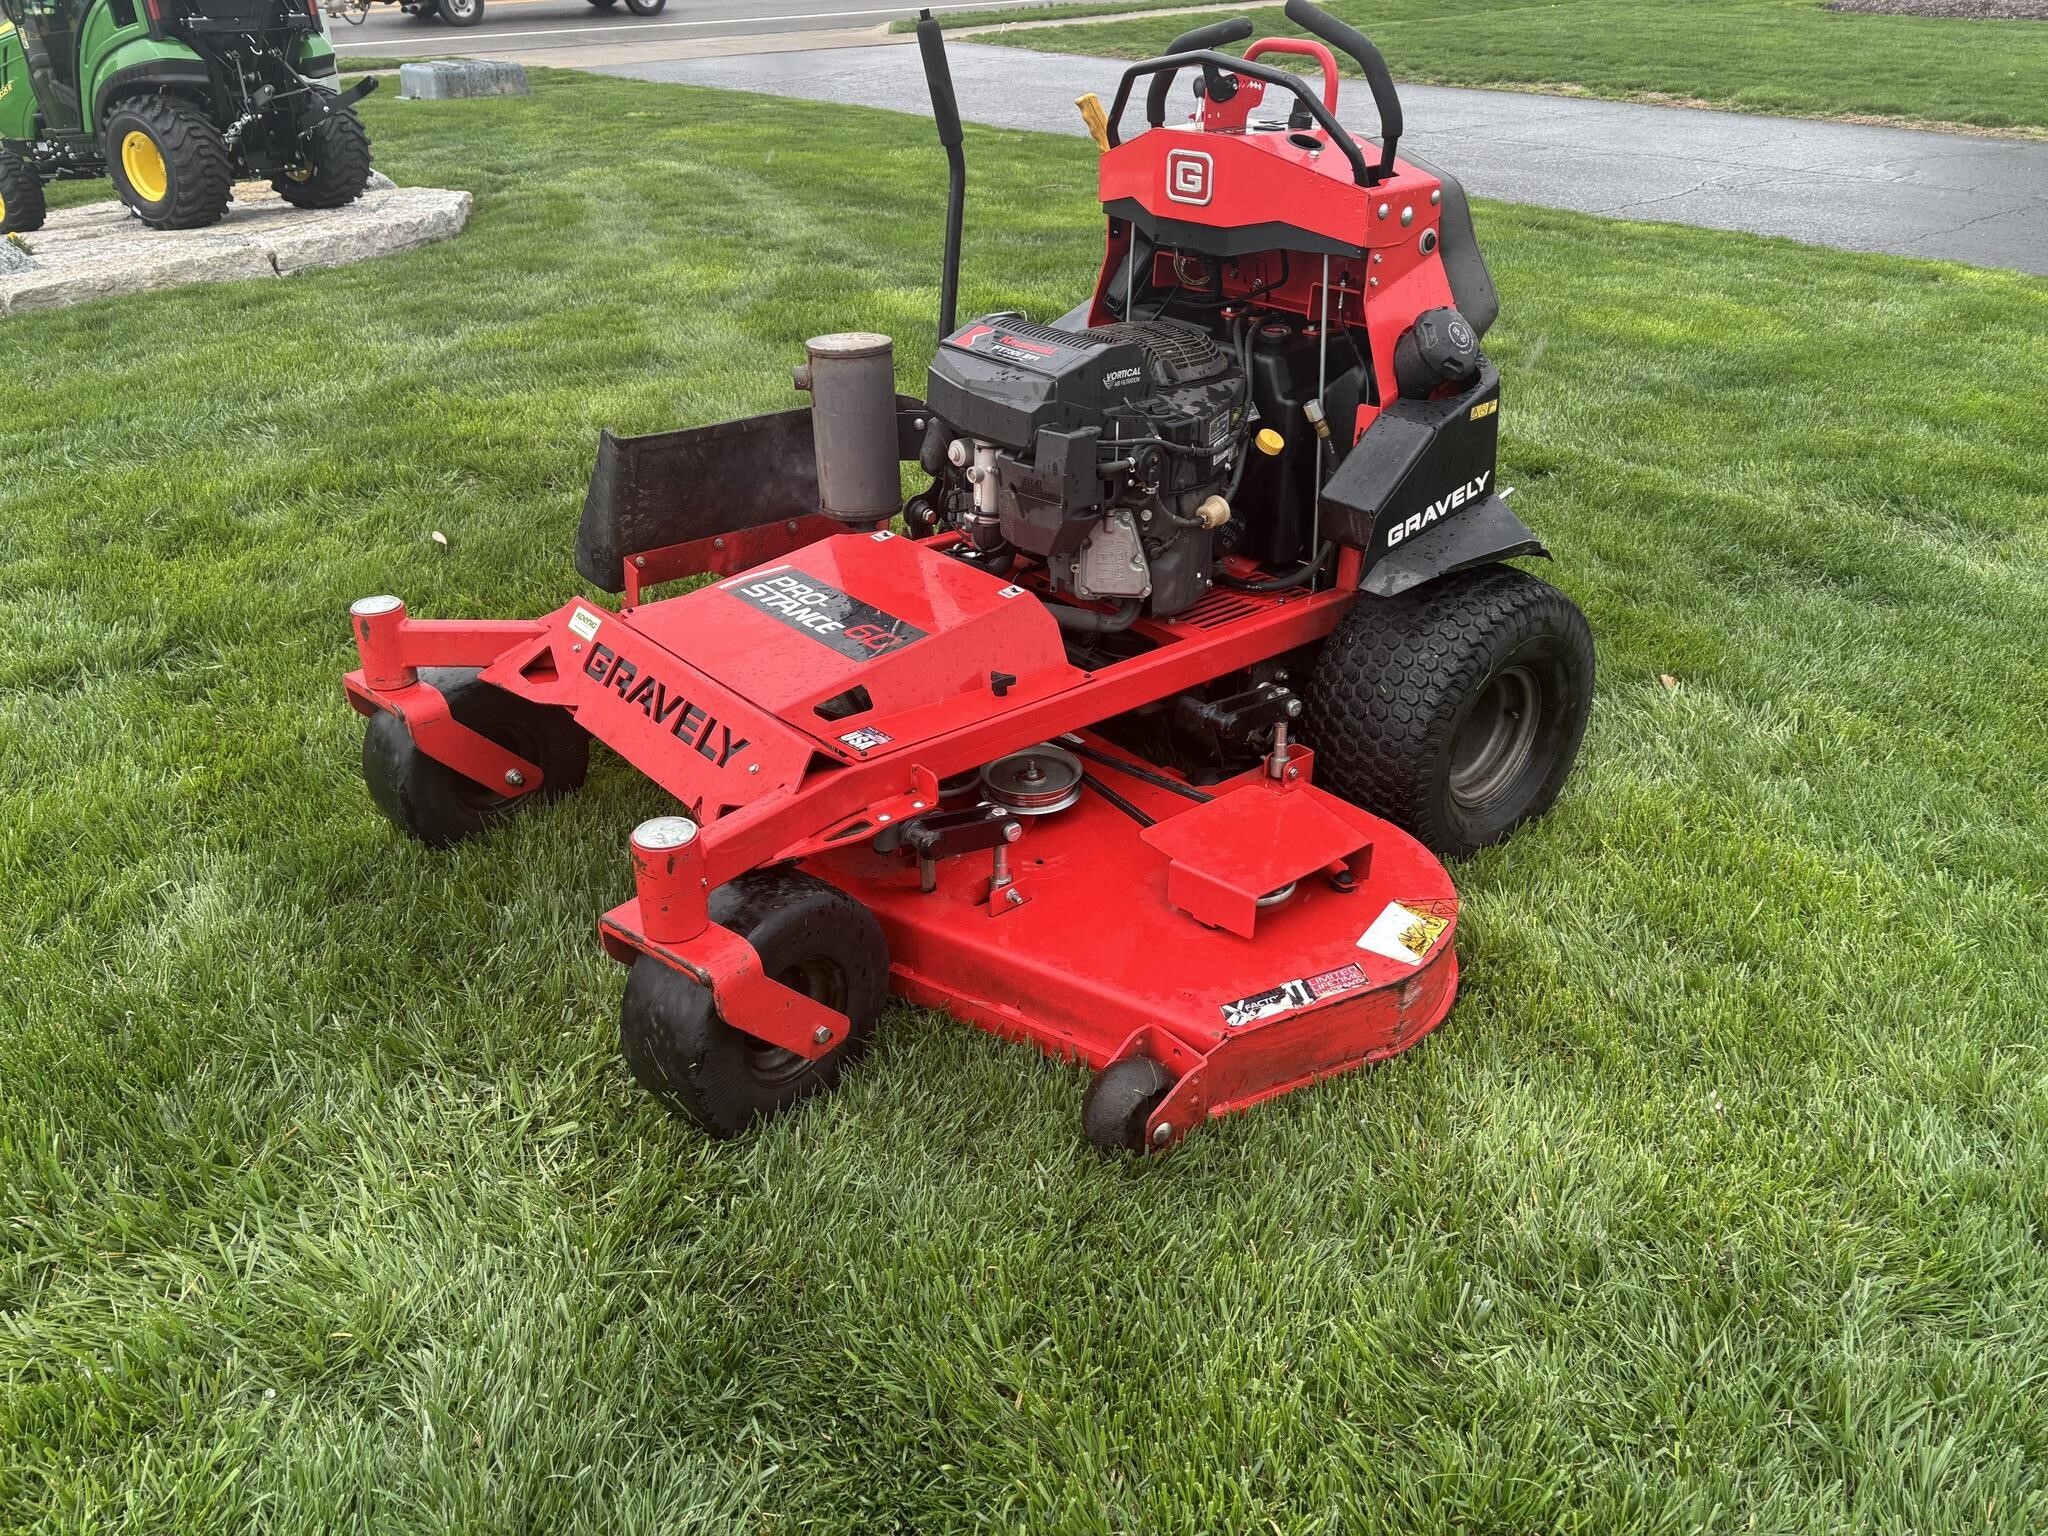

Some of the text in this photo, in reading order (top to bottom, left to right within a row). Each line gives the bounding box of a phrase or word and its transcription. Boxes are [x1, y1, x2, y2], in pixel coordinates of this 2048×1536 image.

[1106, 366, 1141, 381] VORTICAL
[1387, 469, 1491, 547] GRAVELY
[765, 575, 829, 607] PRO-
[740, 583, 847, 635] STANCE
[582, 641, 752, 769] GRAVELY
[840, 731, 877, 750] USA
[1307, 964, 1358, 986] LIMITED
[1310, 972, 1363, 992] LIFETIME
